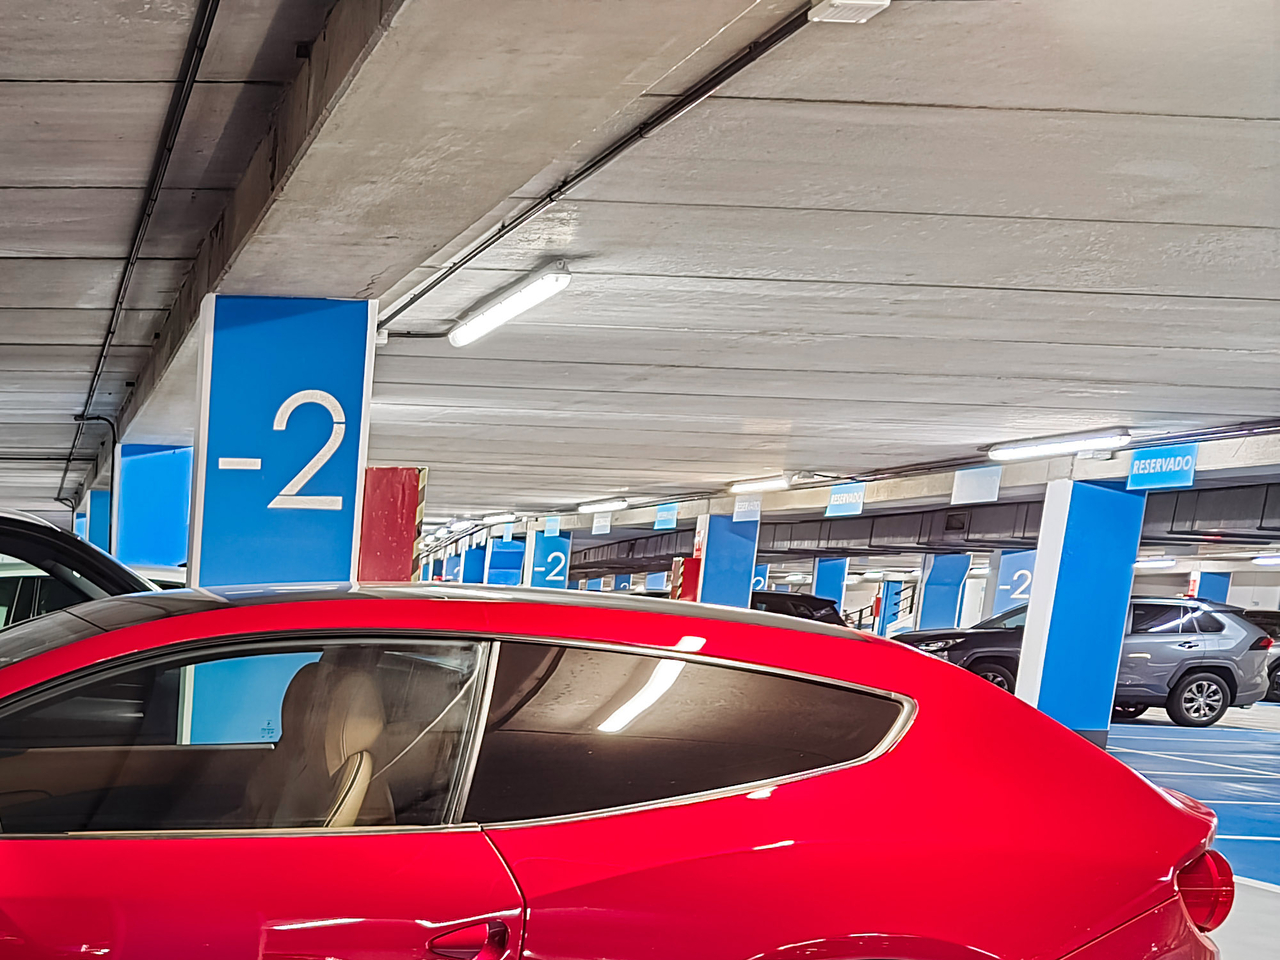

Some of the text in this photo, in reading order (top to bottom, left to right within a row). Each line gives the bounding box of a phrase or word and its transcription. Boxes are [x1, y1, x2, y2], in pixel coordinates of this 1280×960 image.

[218, 389, 346, 510] -2
[1132, 455, 1193, 475] RESERVADO
[533, 551, 566, 581] -2
[999, 569, 1032, 599] -2
